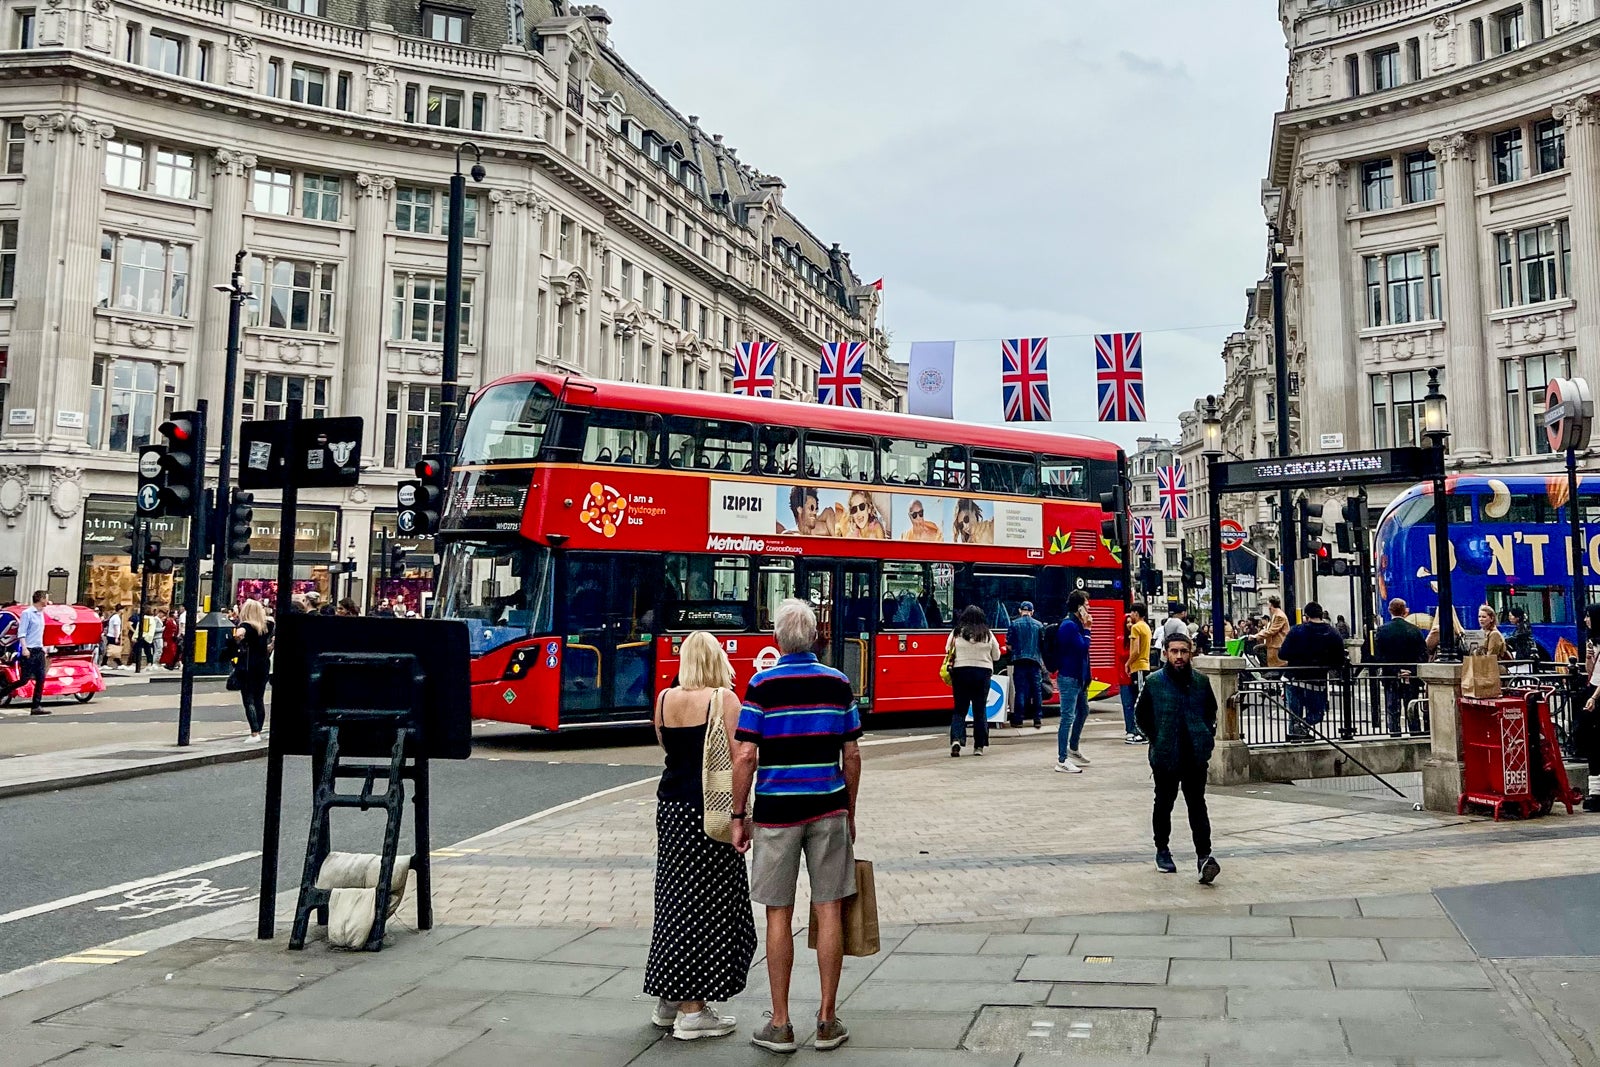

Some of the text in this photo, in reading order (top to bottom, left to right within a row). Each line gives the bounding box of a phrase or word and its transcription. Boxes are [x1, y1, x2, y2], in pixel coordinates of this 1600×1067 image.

[1284, 461, 1326, 475] CIRCUS
[1328, 456, 1382, 472] STATION
[518, 488, 528, 511] 7
[633, 496, 646, 504] am
[648, 496, 653, 504] a
[723, 495, 762, 512] IZIPIZI
[628, 505, 666, 517] hydrogen
[627, 515, 643, 525] bus
[706, 534, 765, 551] Metroline
[679, 610, 686, 621] 7
[1506, 770, 1526, 785] FREE
